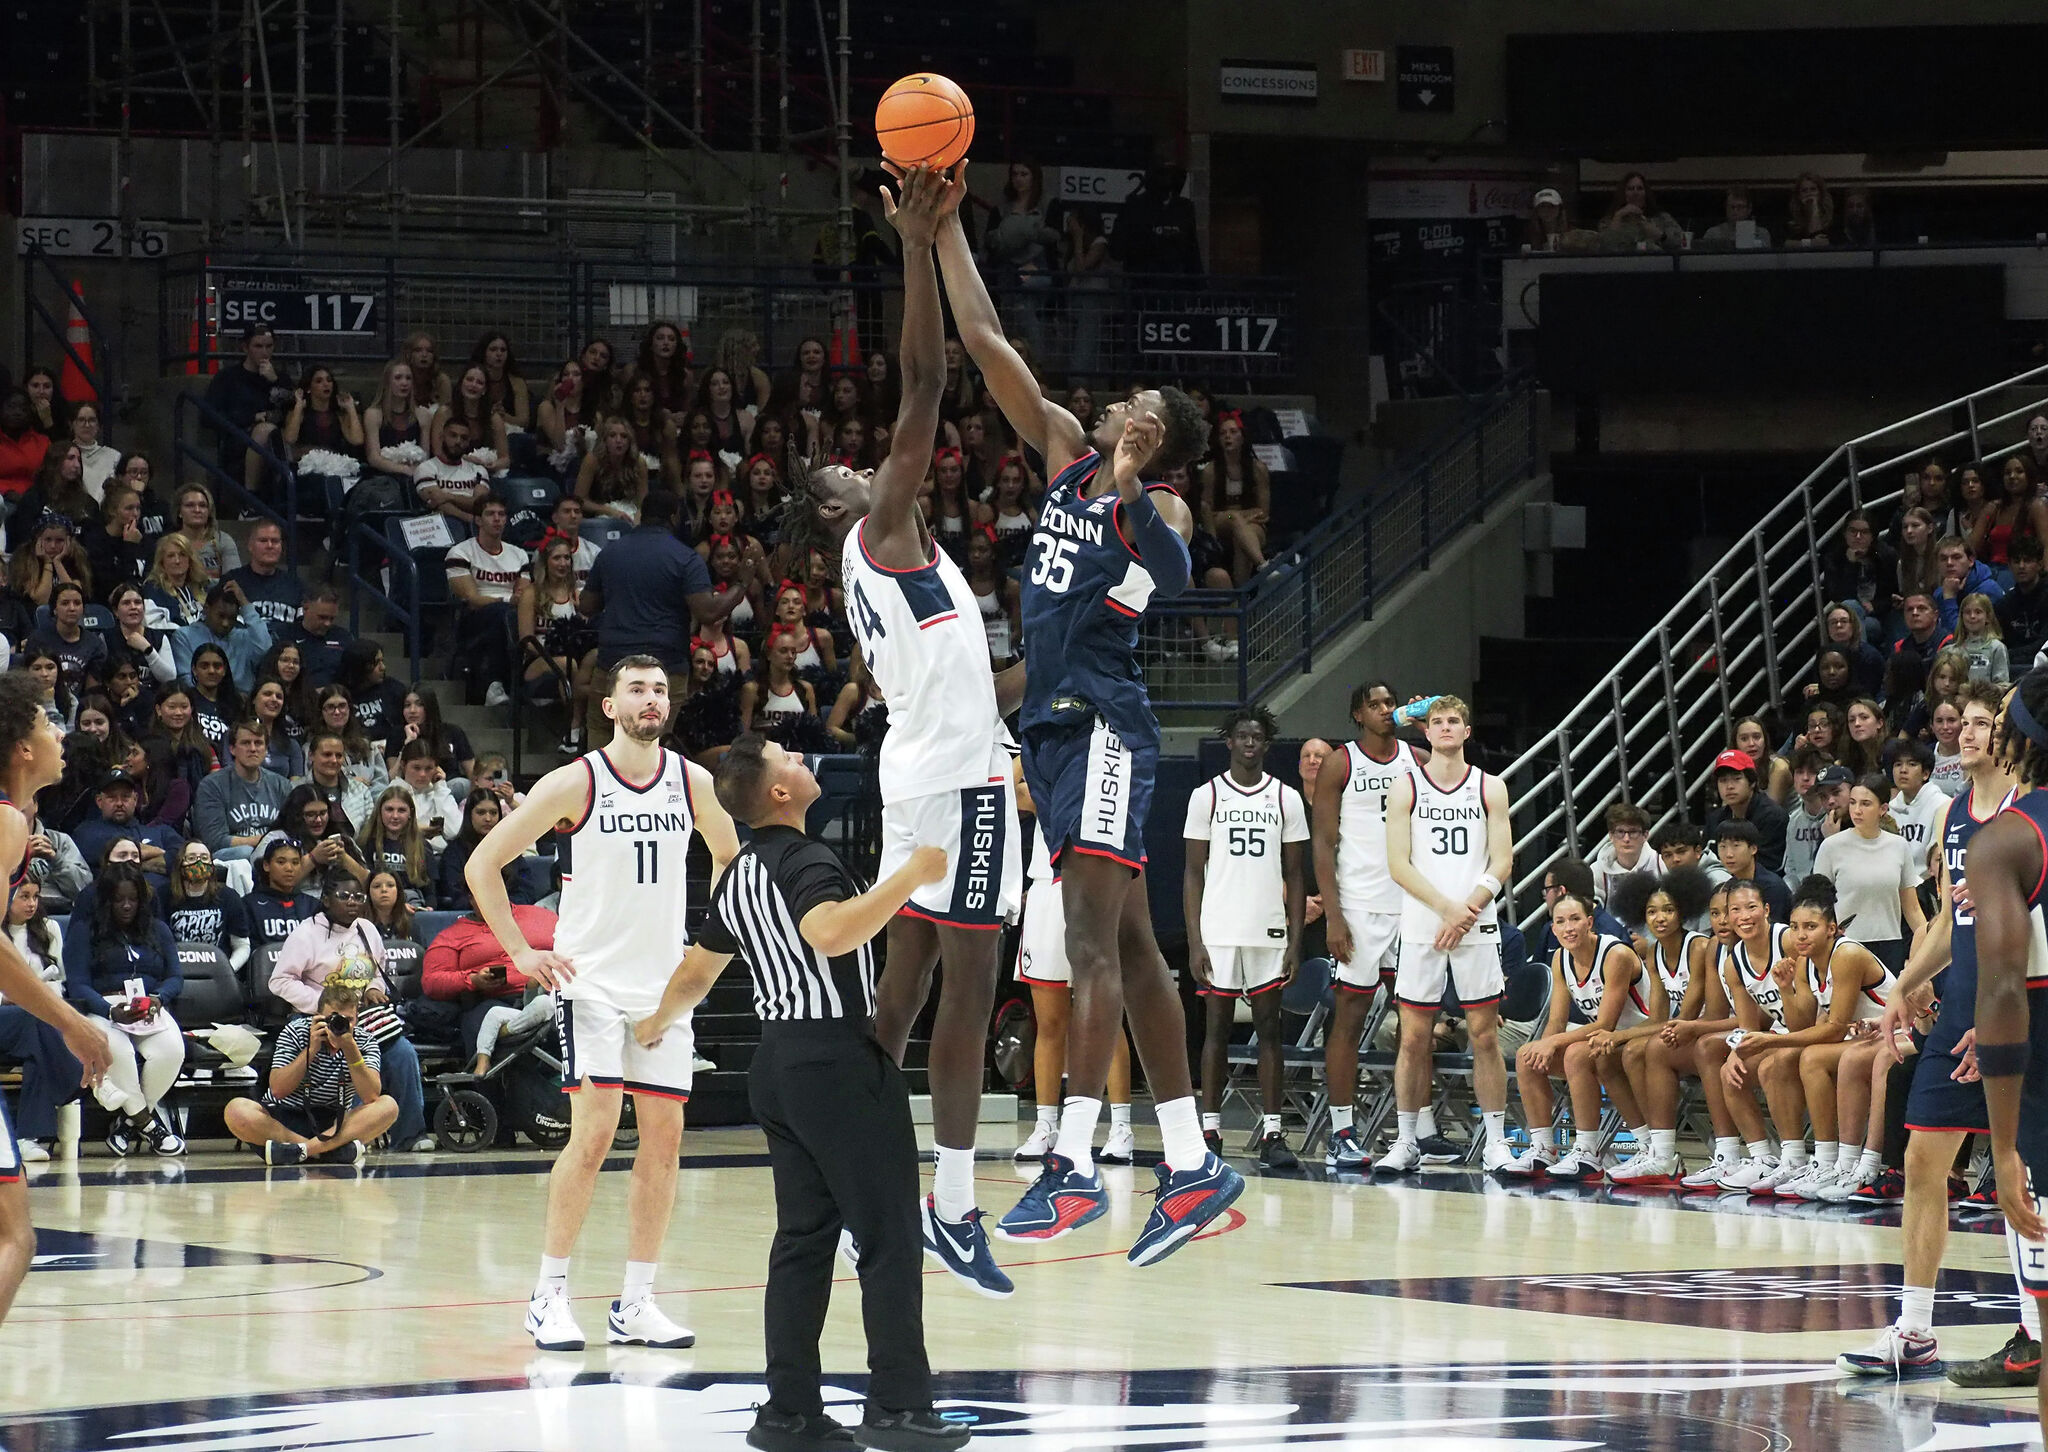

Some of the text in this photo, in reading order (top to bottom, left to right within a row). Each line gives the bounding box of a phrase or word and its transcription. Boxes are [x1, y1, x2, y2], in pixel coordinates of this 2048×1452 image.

[1353, 52, 1379, 76] EXIT
[1223, 76, 1316, 90] CONCESSIONS
[1400, 73, 1453, 84] RESTROOM
[1064, 175, 1107, 195] SEC
[22, 227, 70, 248] SEC
[225, 293, 374, 331] SEC 117
[1144, 316, 1278, 351] SEC 117
[1031, 532, 1080, 594] 35
[1354, 776, 1393, 792] UCO
[229, 803, 280, 824] UCONN
[600, 813, 686, 834] UCONN
[1216, 810, 1279, 826] UCONN
[1418, 806, 1480, 821] UCONN
[1229, 827, 1266, 858] 55
[1431, 826, 1469, 855] 30
[633, 840, 658, 884] 11
[965, 793, 995, 910] HUSKIES
[178, 951, 217, 963] CONN
[385, 948, 417, 960] ONN
[1608, 1141, 1640, 1151] OWERA
